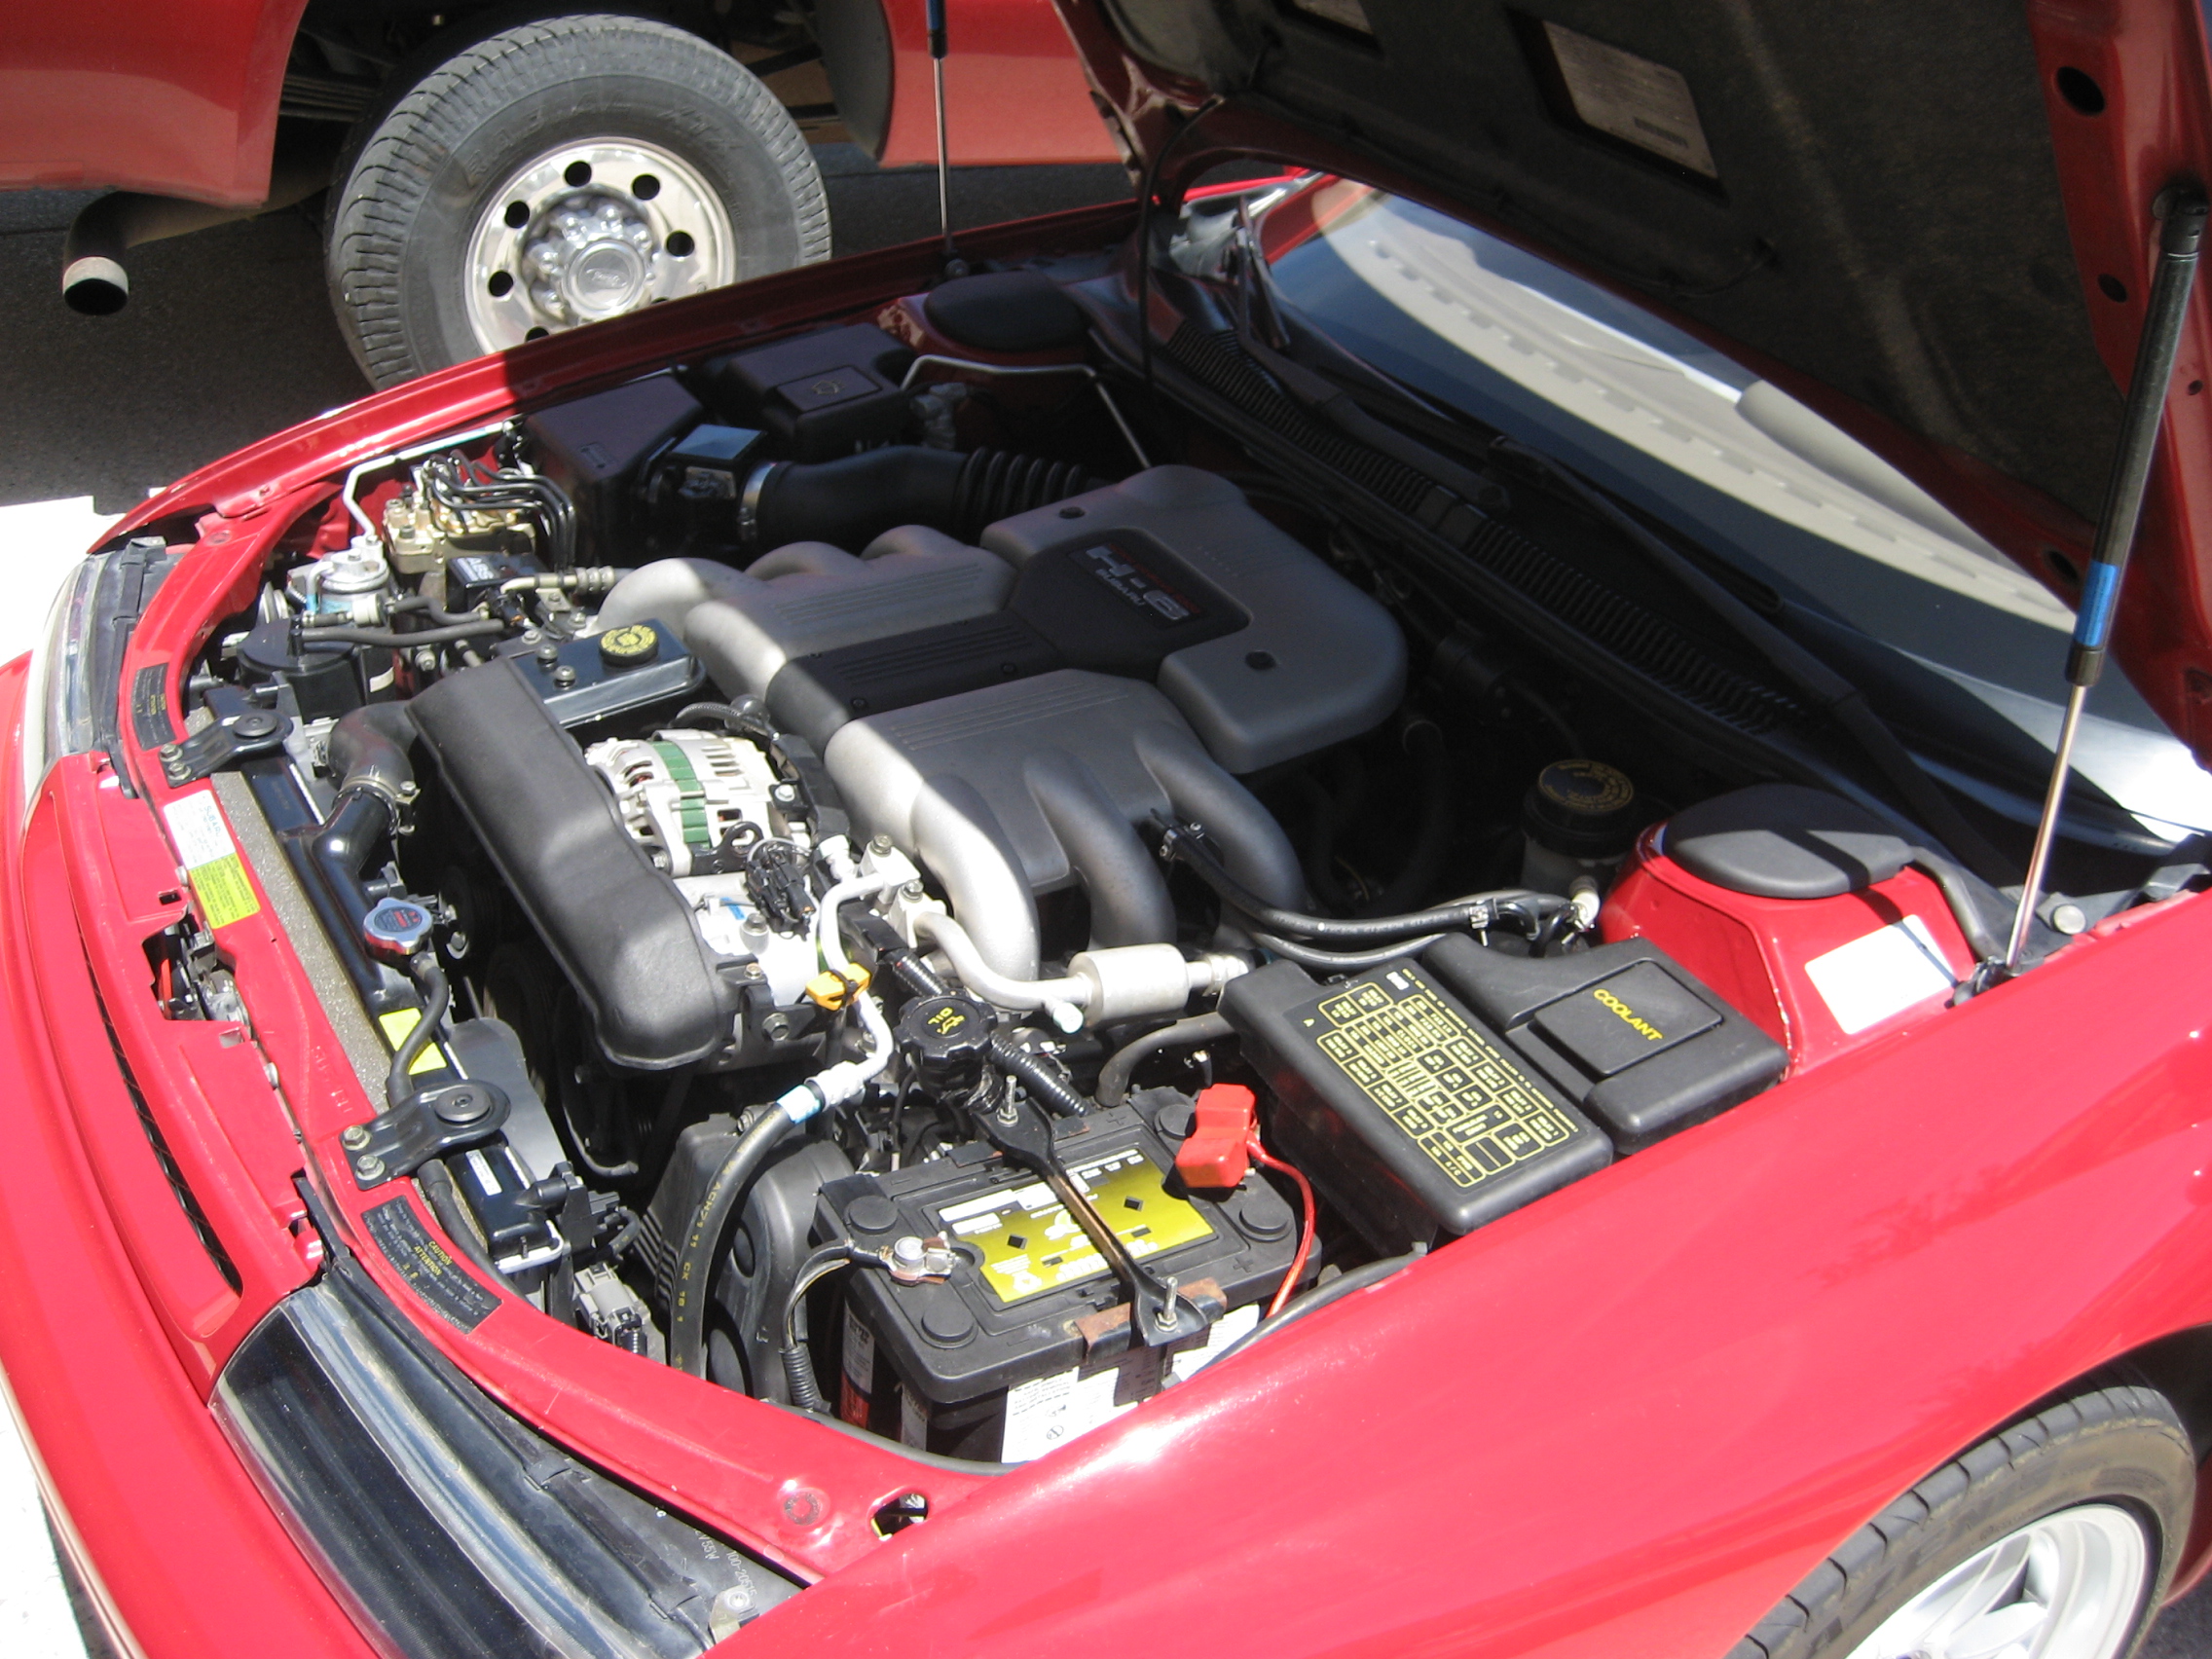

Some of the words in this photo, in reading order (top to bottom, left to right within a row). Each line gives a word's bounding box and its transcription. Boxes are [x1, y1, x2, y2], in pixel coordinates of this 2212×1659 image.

[466, 557, 495, 580] ABS
[1098, 568, 1146, 608] SUBARU
[927, 1006, 954, 1026] OIL
[1302, 1016, 1316, 1027] A
[1593, 988, 1664, 1042] COOLANT
[1394, 1028, 1419, 1050] CLOCK
[413, 1245, 443, 1276] ATTENTION
[427, 1240, 453, 1266] CAUTION
